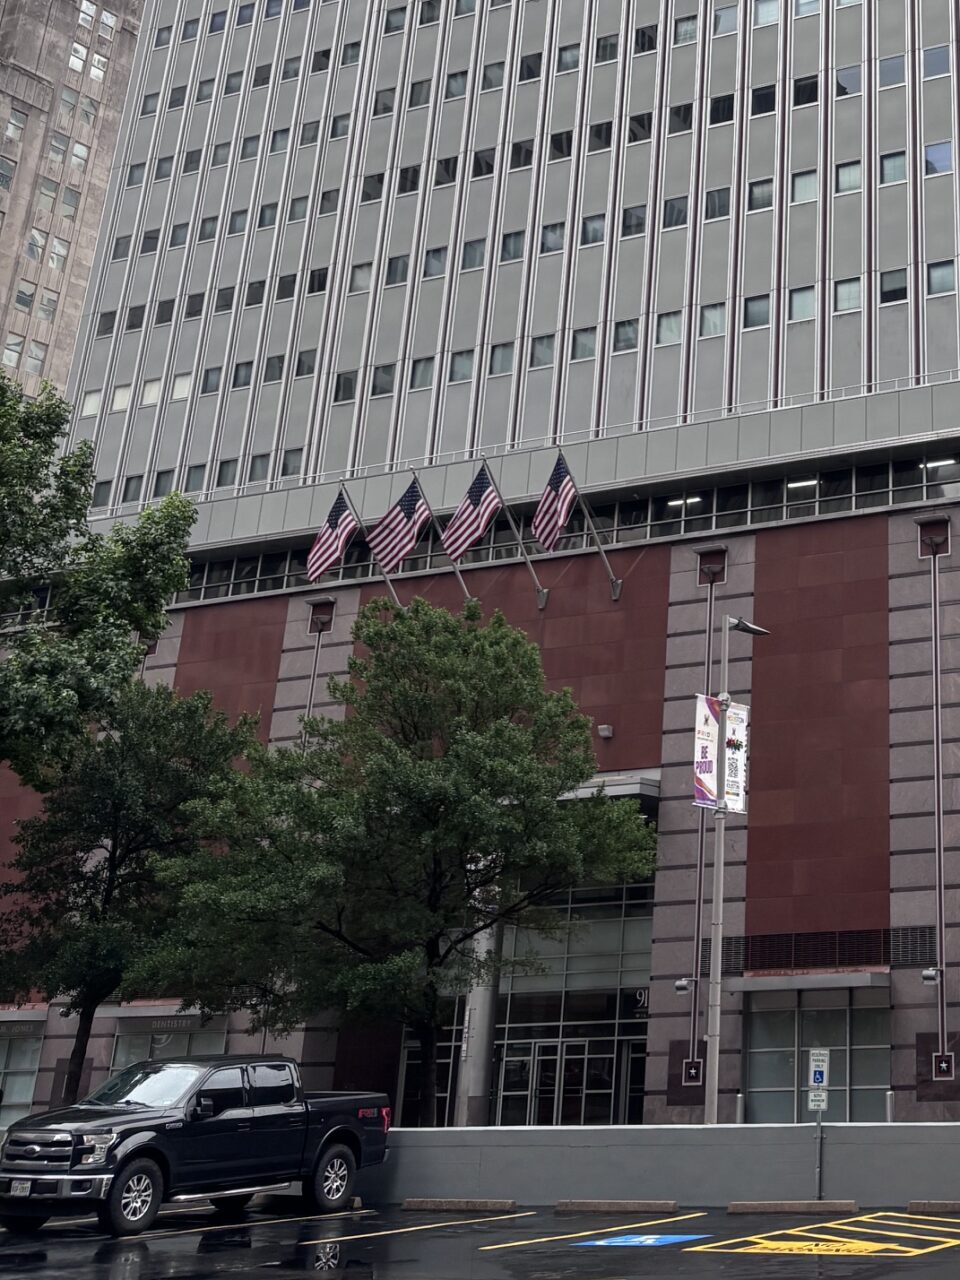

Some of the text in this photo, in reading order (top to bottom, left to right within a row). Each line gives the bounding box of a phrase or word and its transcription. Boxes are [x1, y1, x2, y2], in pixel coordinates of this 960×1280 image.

[701, 745, 708, 759] BE
[696, 760, 713, 774] PROUD
[152, 1020, 191, 1028] DENTISTRY
